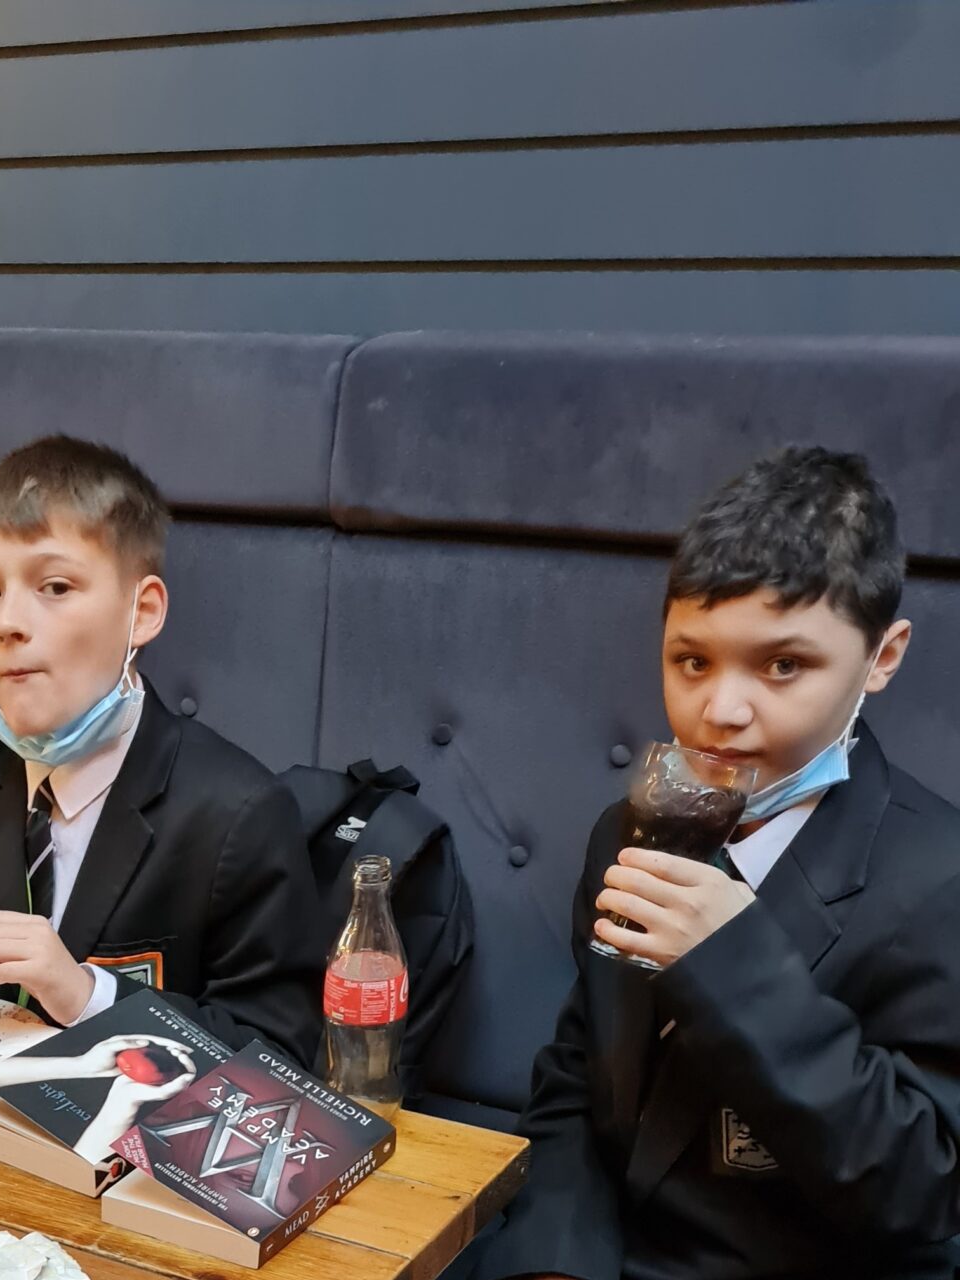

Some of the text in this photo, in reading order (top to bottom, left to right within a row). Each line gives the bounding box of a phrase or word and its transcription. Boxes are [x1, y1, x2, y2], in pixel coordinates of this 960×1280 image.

[149, 1006, 227, 1063] TEPHENIE MEYER
[39, 1081, 92, 1121] twilight
[258, 1053, 372, 1127] RICHELLE MEAD
[208, 1097, 307, 1165] VAMPIRE
[209, 1084, 330, 1160] ACADEMY
[165, 1162, 228, 1204] VAMPIRE ACADEMY
[335, 1159, 377, 1200] ACADEMY
[339, 1150, 375, 1185] VAMPIRE
[284, 1210, 309, 1238] MEAD
